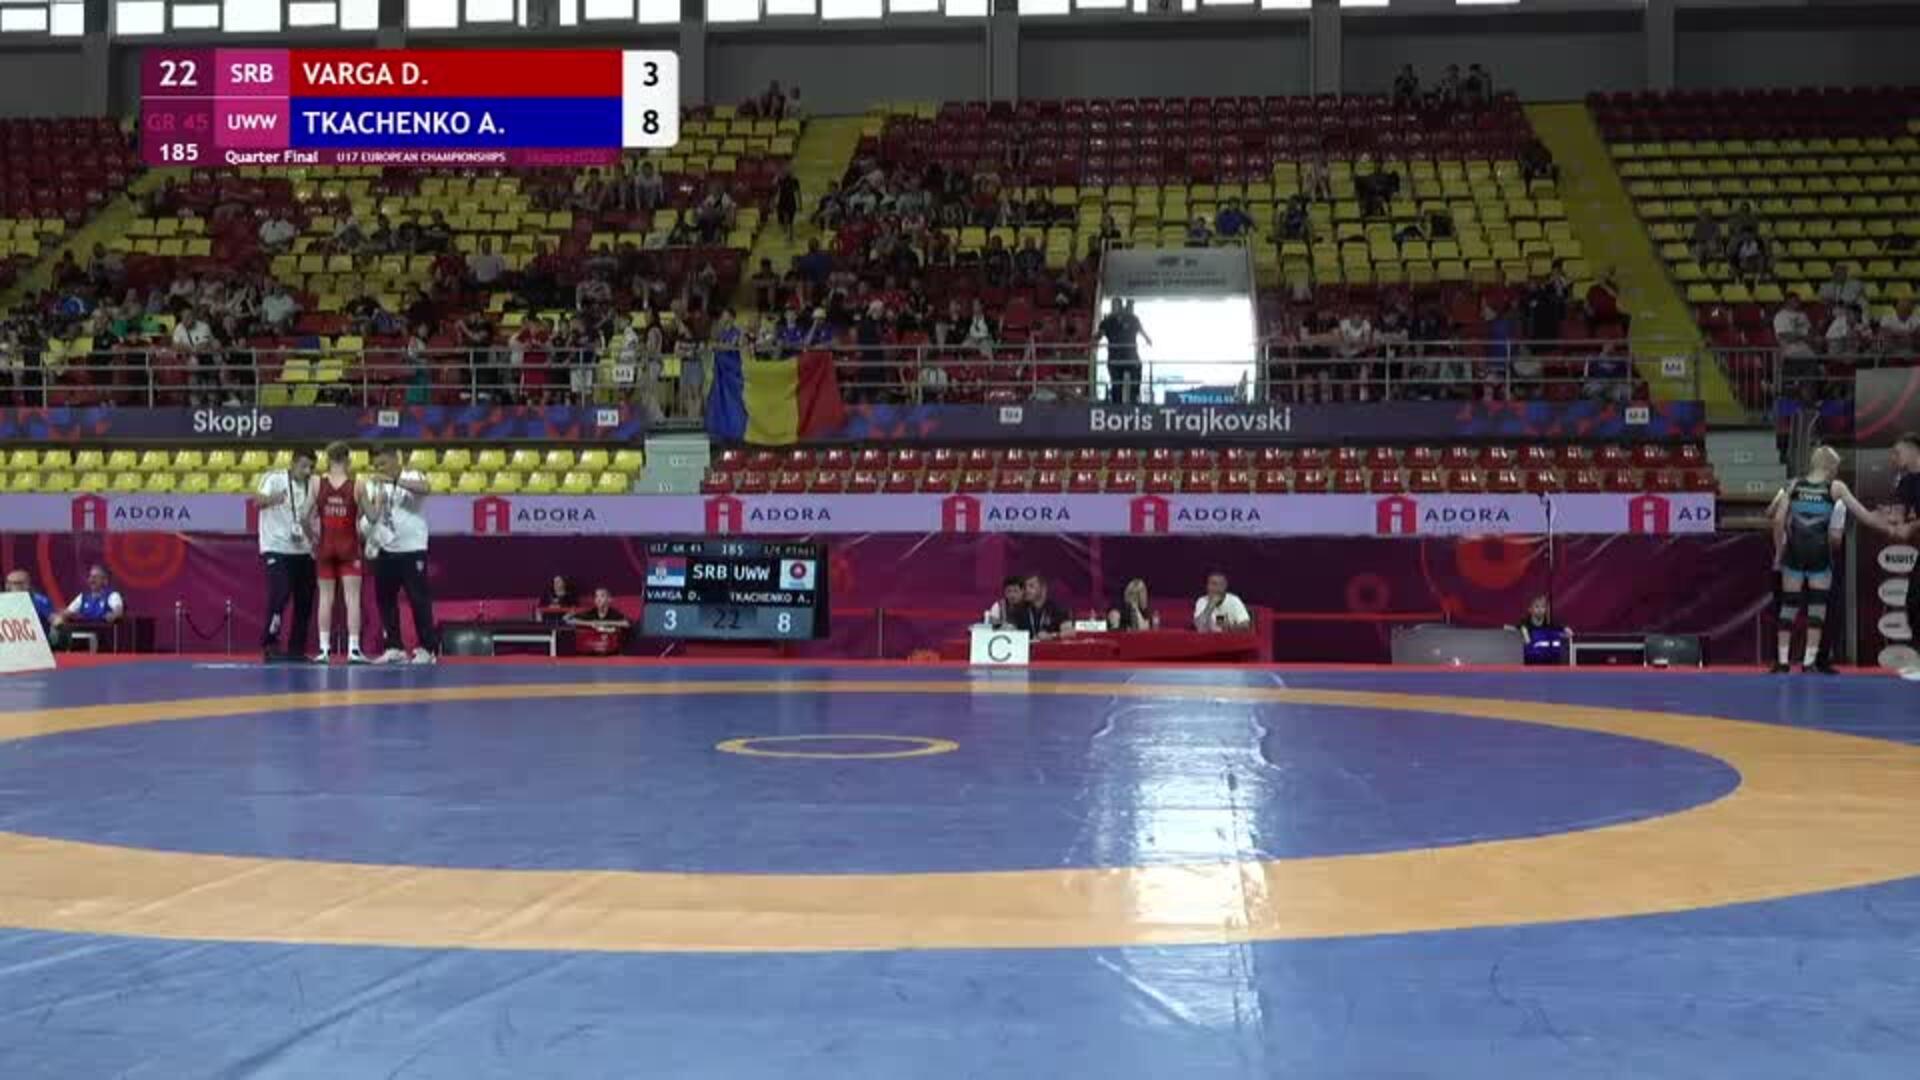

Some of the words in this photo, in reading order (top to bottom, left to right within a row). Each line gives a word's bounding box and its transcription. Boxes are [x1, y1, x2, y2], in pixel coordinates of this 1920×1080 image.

[193, 410, 273, 436] Skopje
[1090, 407, 1153, 431] Boris
[1160, 407, 1291, 437] Trajkovski
[114, 505, 191, 521] ADORA
[517, 507, 597, 522] ADORA
[750, 506, 831, 521] ADORA
[987, 506, 1071, 522] ADORA
[1177, 506, 1261, 522] ADORA
[1424, 507, 1511, 522] ADORA
[1678, 507, 1712, 522] AD
[721, 544, 744, 556] 185
[692, 564, 728, 580] SRB
[734, 565, 771, 581] UWW
[647, 591, 682, 601] VARGA
[730, 591, 793, 604] TKACHENKO
[663, 609, 677, 631] 3
[712, 607, 743, 630] 22
[776, 612, 792, 633] 8
[987, 634, 1012, 663] C
